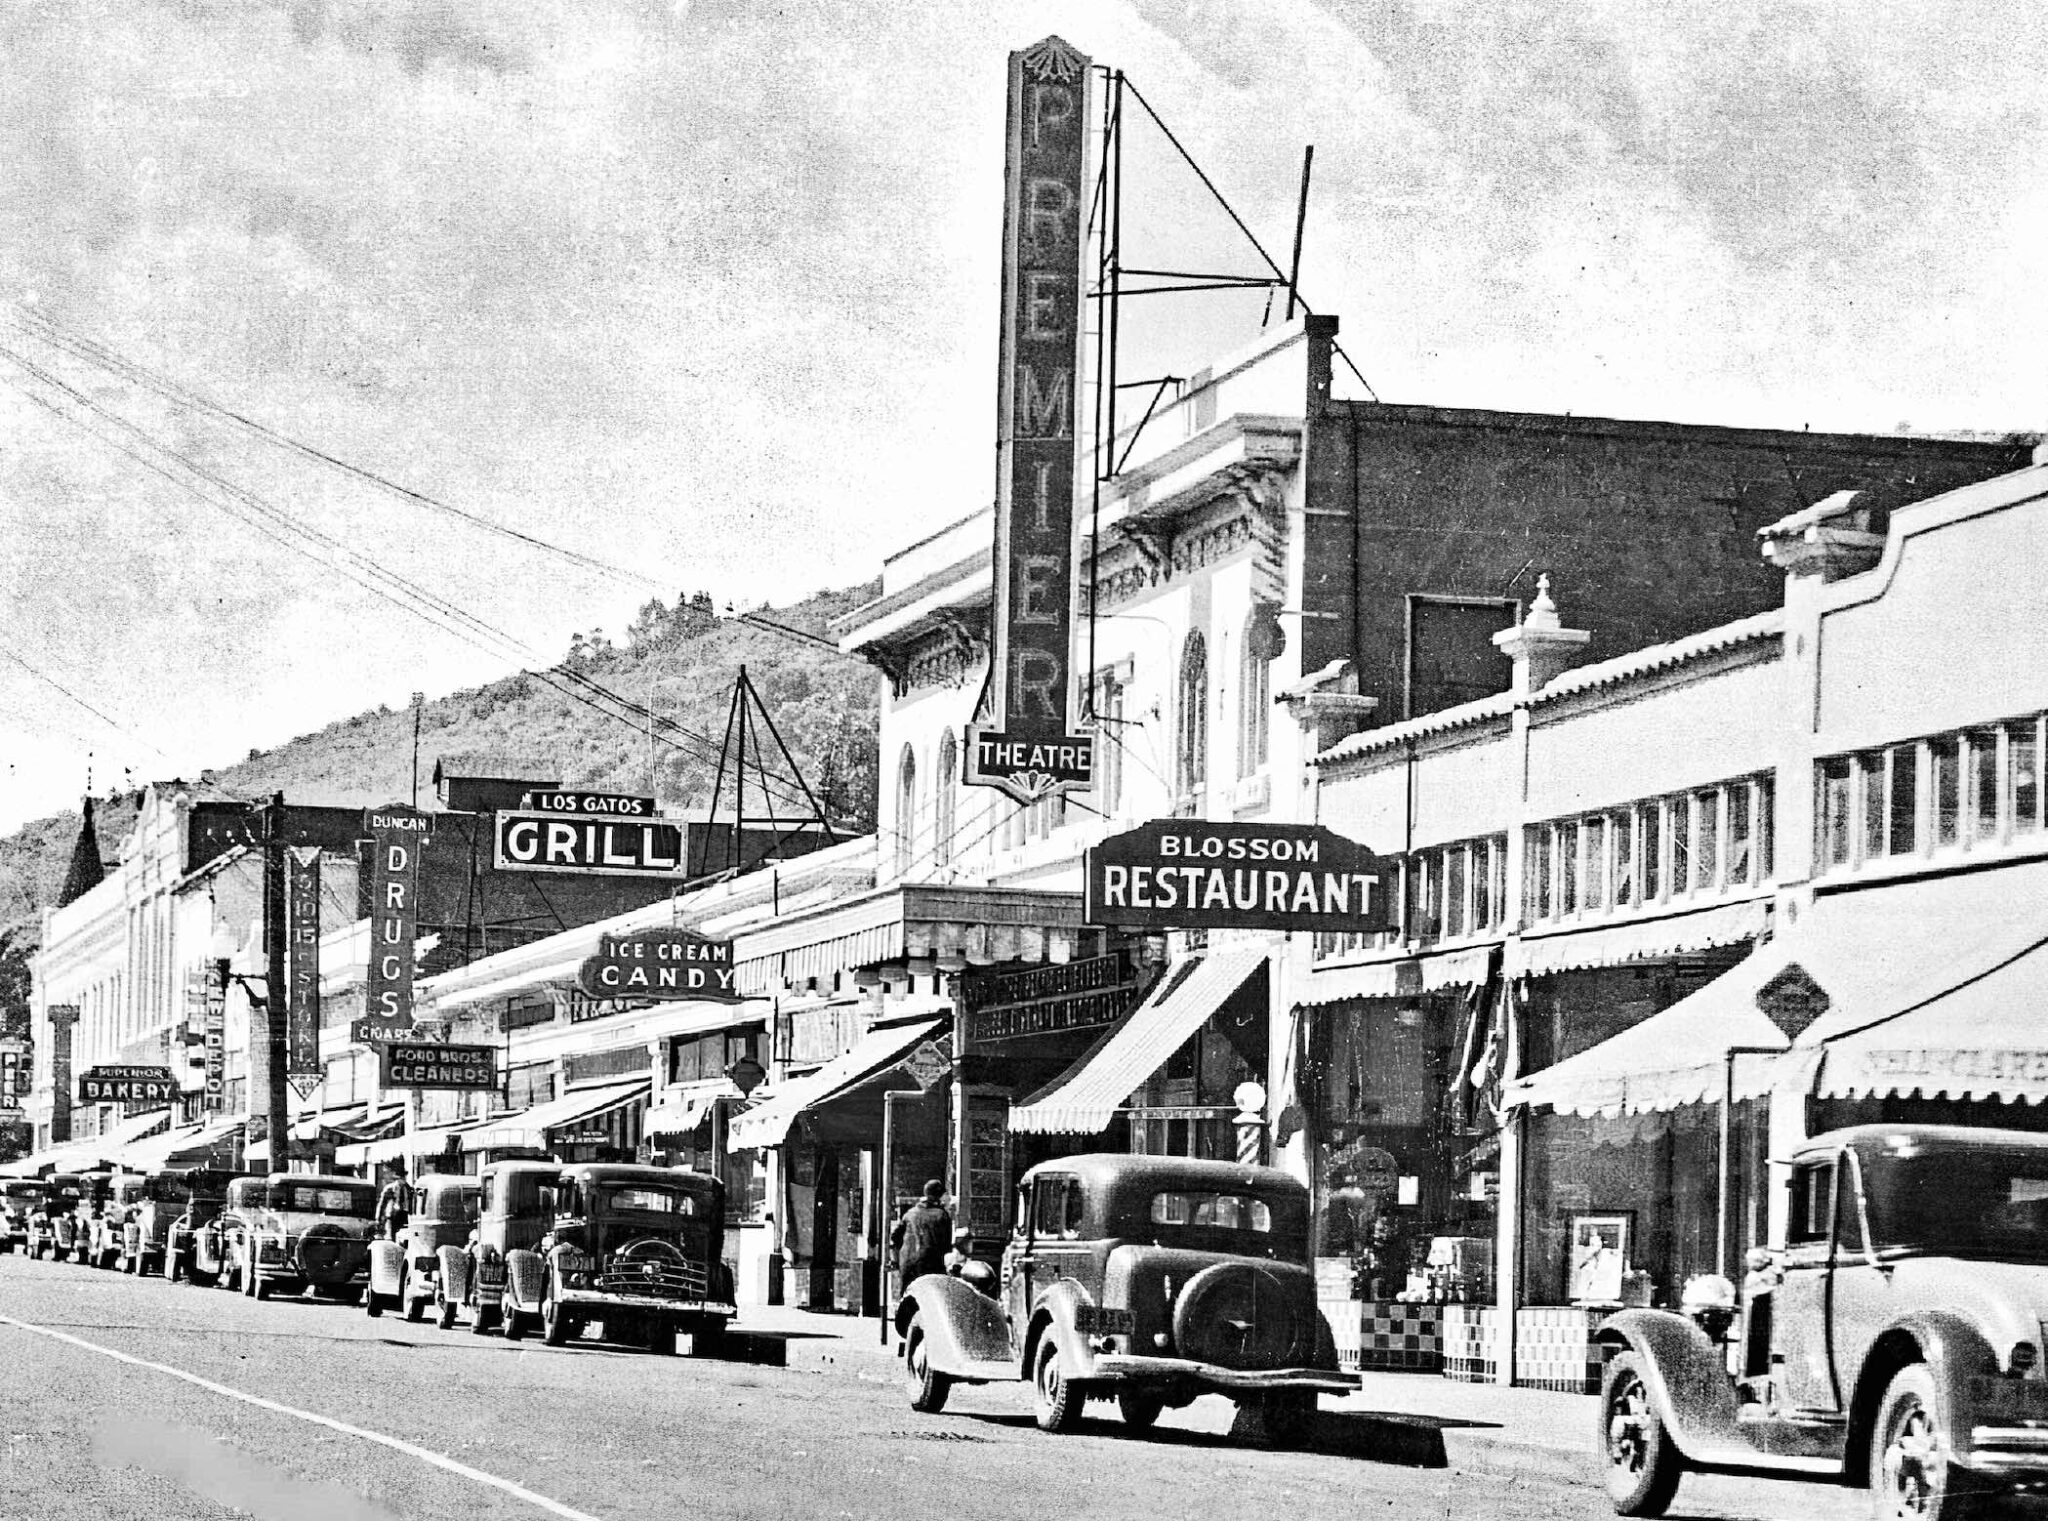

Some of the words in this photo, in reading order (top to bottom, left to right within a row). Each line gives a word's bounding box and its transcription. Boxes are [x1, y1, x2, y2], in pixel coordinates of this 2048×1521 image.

[1007, 83, 1073, 720] PREMIER
[979, 742, 1090, 770] THEATRE
[541, 794, 577, 811] LOS
[582, 797, 643, 814] GATOS
[372, 815, 427, 831] DUNCAN
[507, 821, 675, 868] GRILL
[1160, 835, 1319, 863] BLOSSOM
[1104, 865, 1379, 915] RESTAURANT
[380, 845, 408, 1018] DRUGS
[609, 942, 644, 958] ICE
[658, 944, 726, 961] CREAM
[601, 965, 735, 989] CANDY
[395, 1049, 435, 1062] FORD
[99, 1068, 164, 1078] SUPERIOR
[390, 1065, 490, 1083] CLEANERS
[87, 1082, 172, 1100] BAKERY
